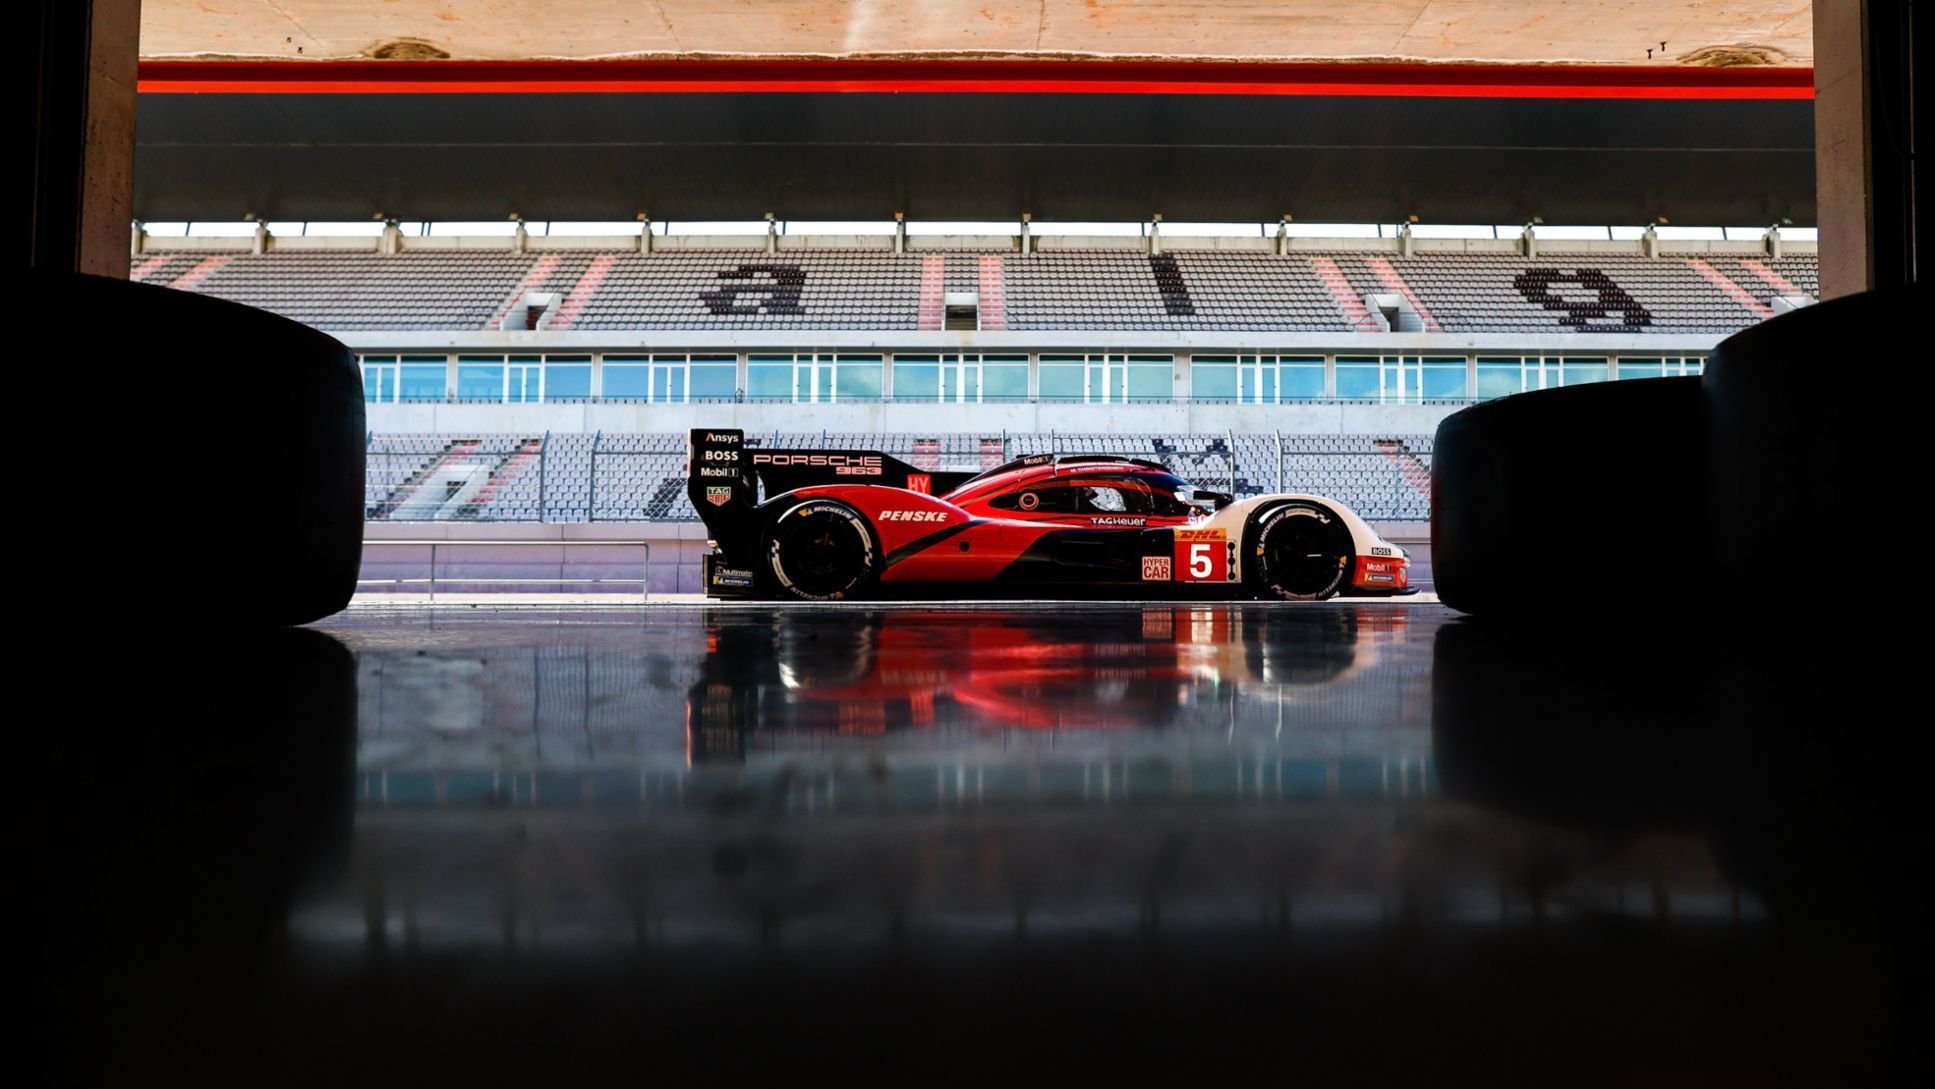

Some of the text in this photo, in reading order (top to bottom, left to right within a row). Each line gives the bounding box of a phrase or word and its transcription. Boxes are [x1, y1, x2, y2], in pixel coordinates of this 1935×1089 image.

[706, 432, 739, 444] Ansys
[705, 450, 739, 461] BOSS
[753, 454, 882, 466] PORSCHE
[701, 467, 727, 477] Mobil
[836, 467, 882, 475] 963
[908, 476, 928, 494] HY
[813, 506, 853, 520] MICHELIN
[878, 510, 948, 522] PENSKE
[1180, 530, 1221, 539] DHL
[1143, 558, 1169, 566] HYPER
[1189, 544, 1213, 579] 5
[1366, 563, 1385, 571] Mobil
[1143, 566, 1169, 579] CAR
